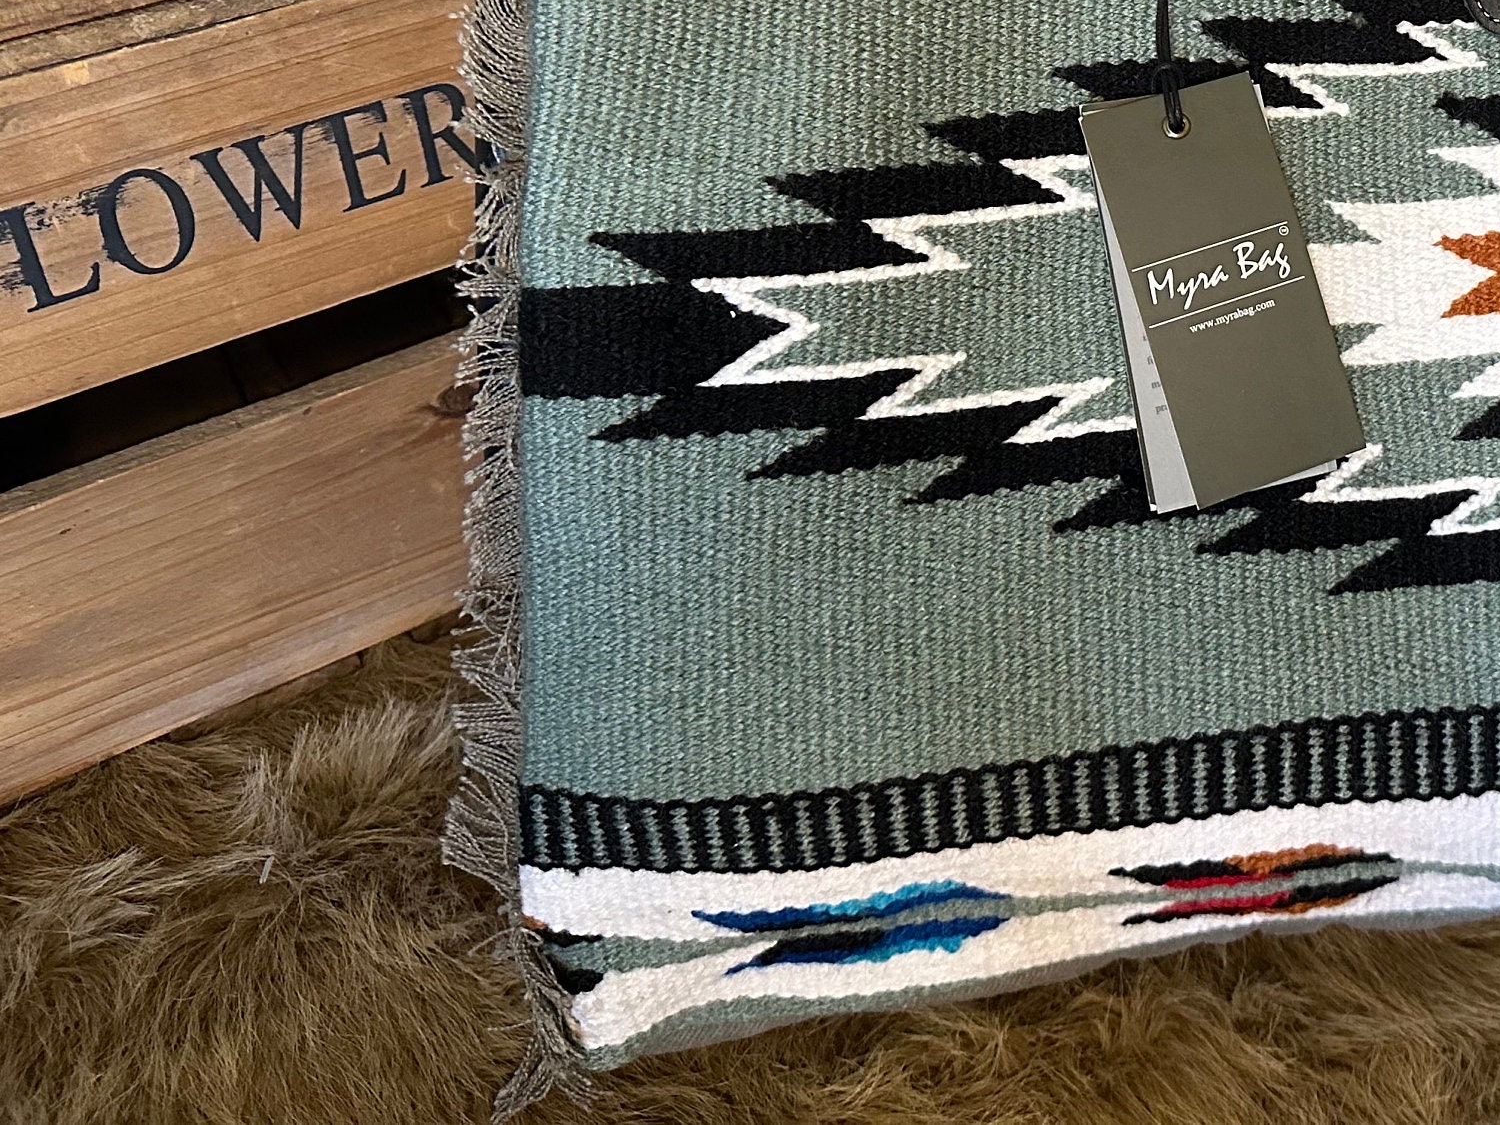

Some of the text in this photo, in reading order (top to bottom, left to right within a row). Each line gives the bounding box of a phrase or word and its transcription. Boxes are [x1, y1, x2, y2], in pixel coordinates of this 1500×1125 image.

[0, 83, 476, 312] LOWER
[1147, 241, 1291, 310] Myra Bag
[1189, 299, 1276, 333] www.myrabag.com
